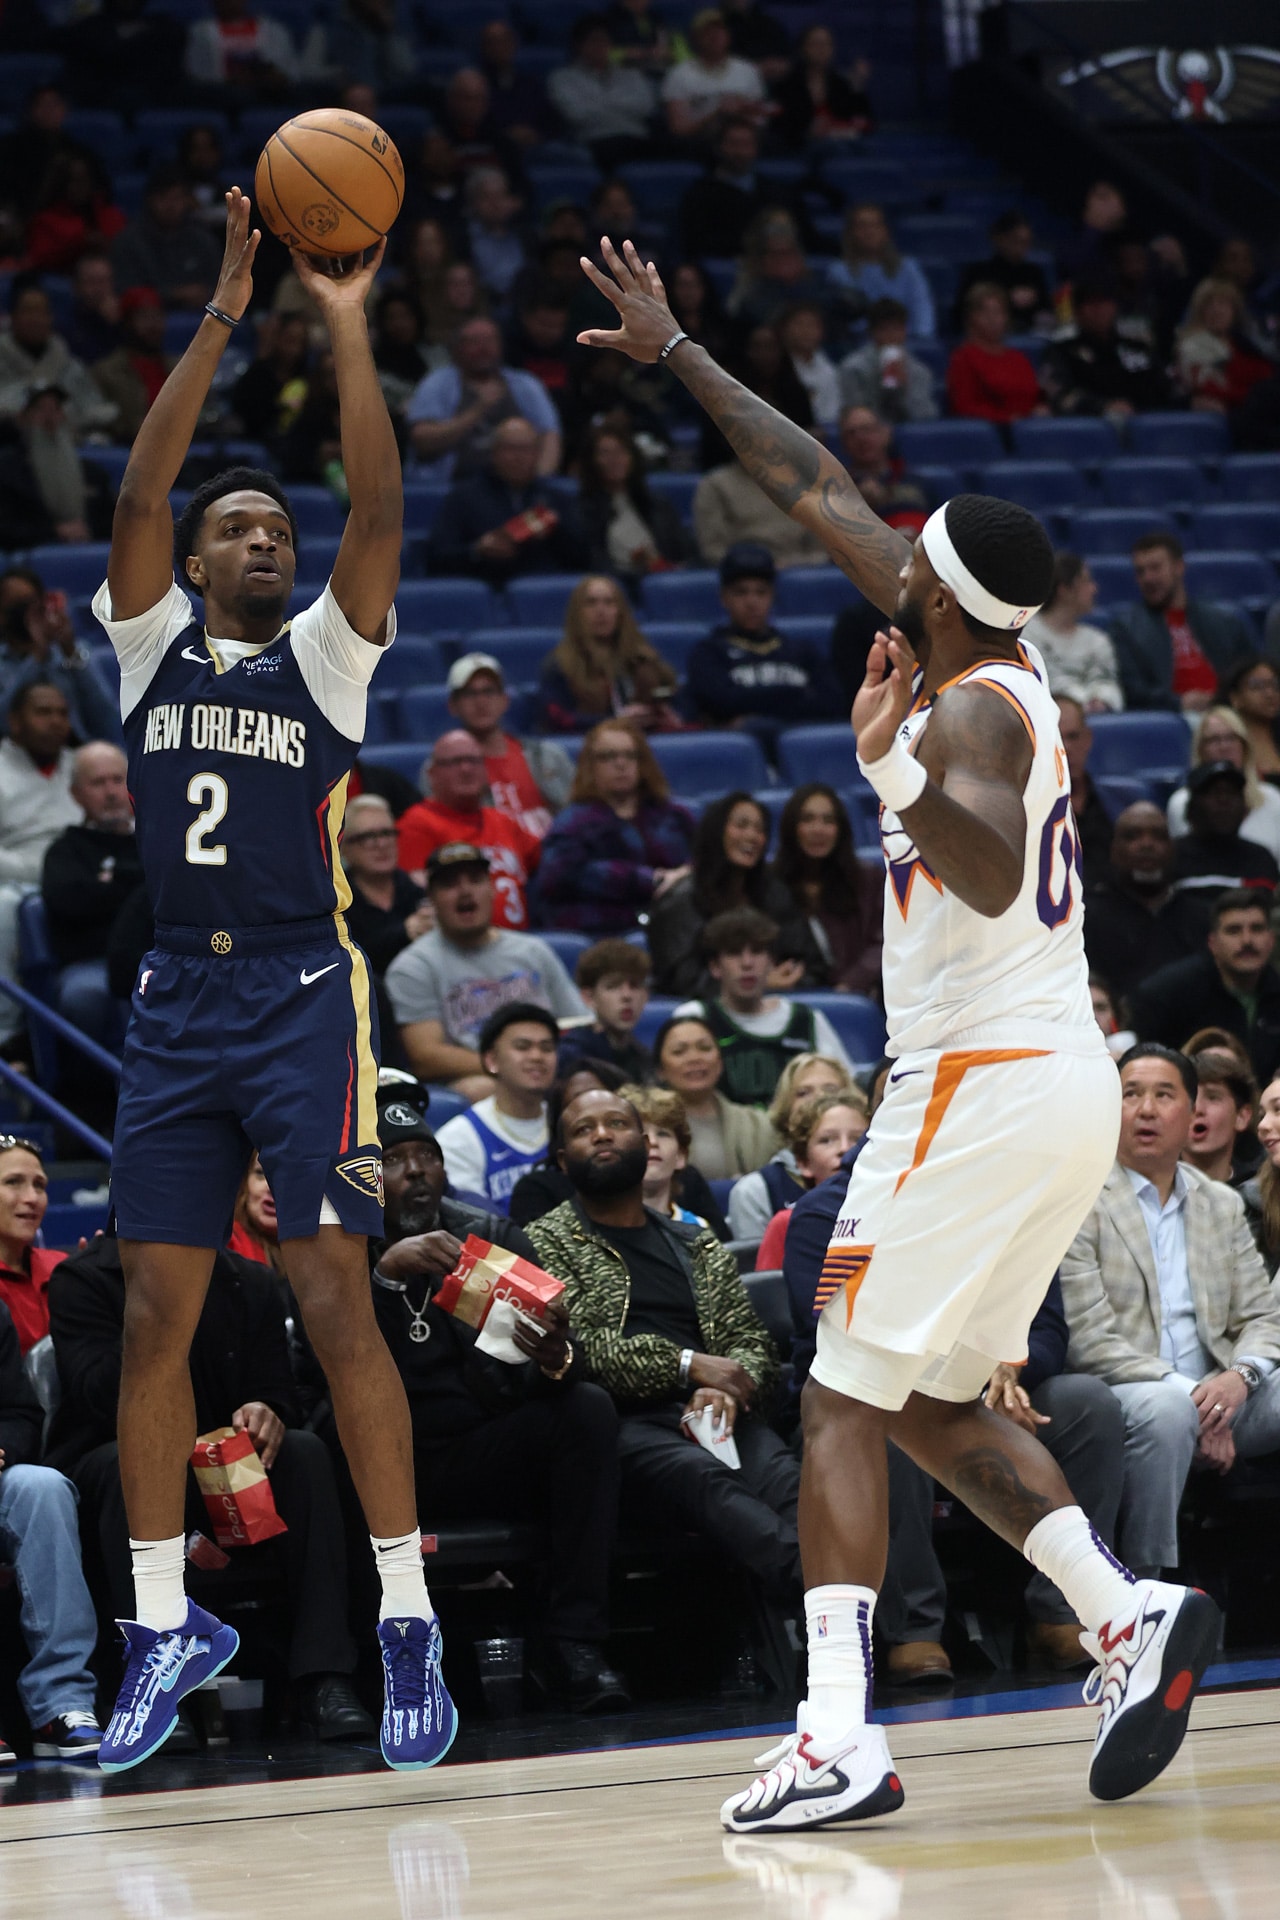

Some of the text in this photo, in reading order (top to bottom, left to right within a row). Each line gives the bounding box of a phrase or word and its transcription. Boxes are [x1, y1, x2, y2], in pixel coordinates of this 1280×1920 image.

[246, 665, 279, 676] GARAGE
[143, 704, 306, 768] NEW ORLEANS
[185, 772, 229, 866] 2
[1036, 793, 1082, 931] 0
